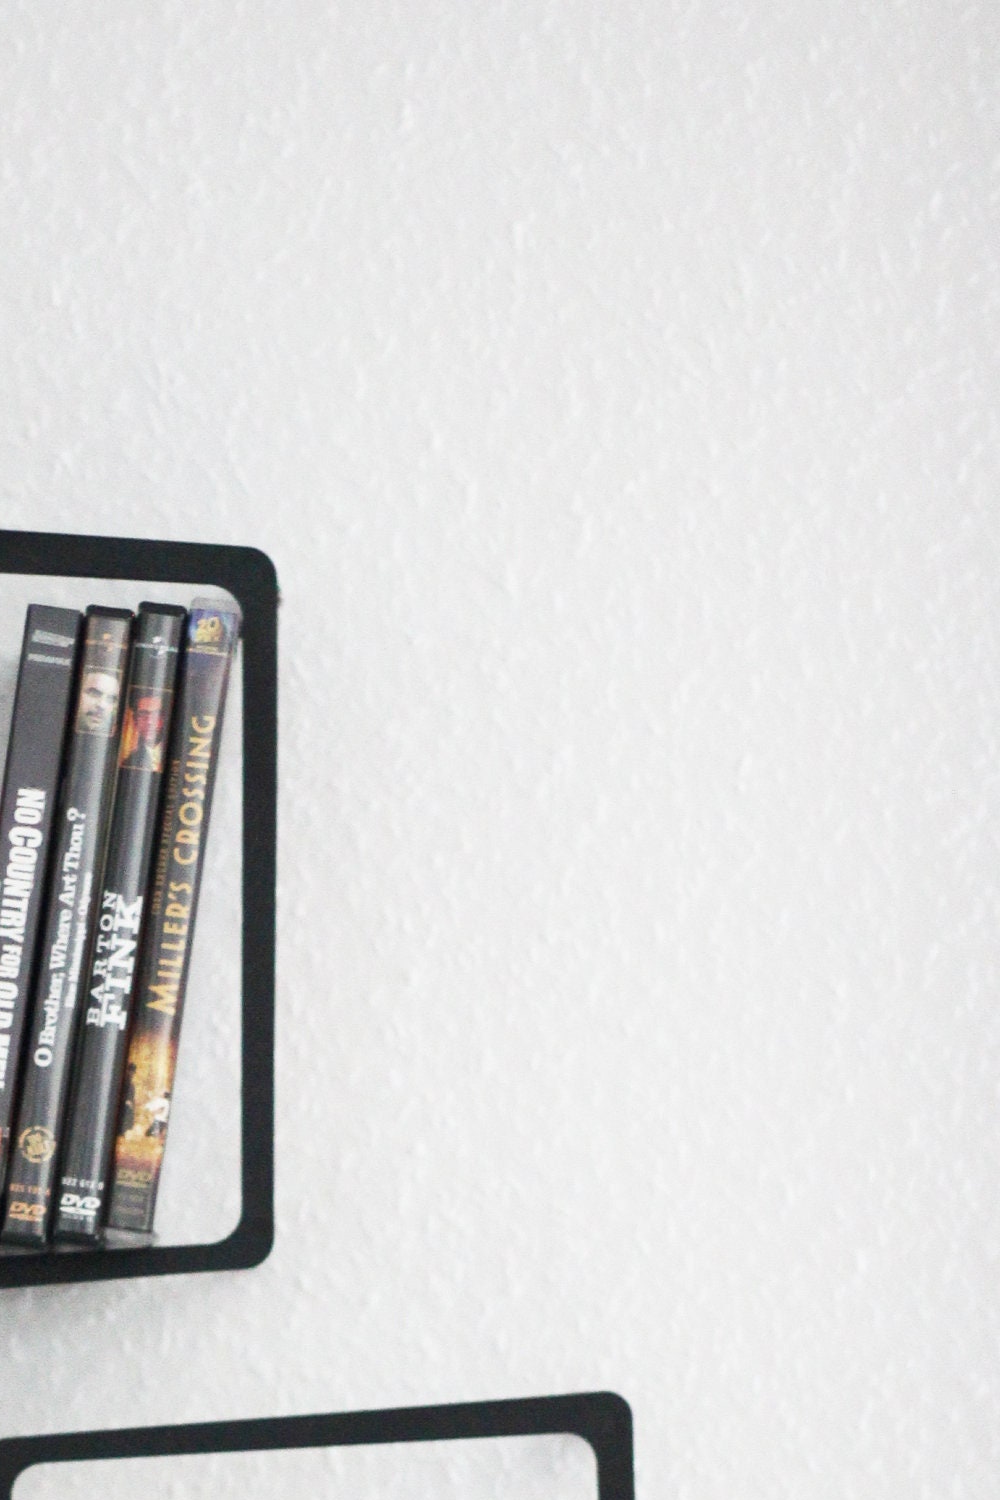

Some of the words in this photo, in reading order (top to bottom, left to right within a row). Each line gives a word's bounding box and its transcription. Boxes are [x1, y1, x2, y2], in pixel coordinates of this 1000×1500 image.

[13, 787, 47, 826] NO
[58, 873, 78, 908] Art
[145, 881, 192, 1016] MILLER'S
[173, 714, 217, 866] CROSSING
[49, 908, 72, 971] Where
[85, 889, 119, 1027] BARTON
[99, 893, 143, 1031] FINK
[33, 1047, 53, 1067] O
